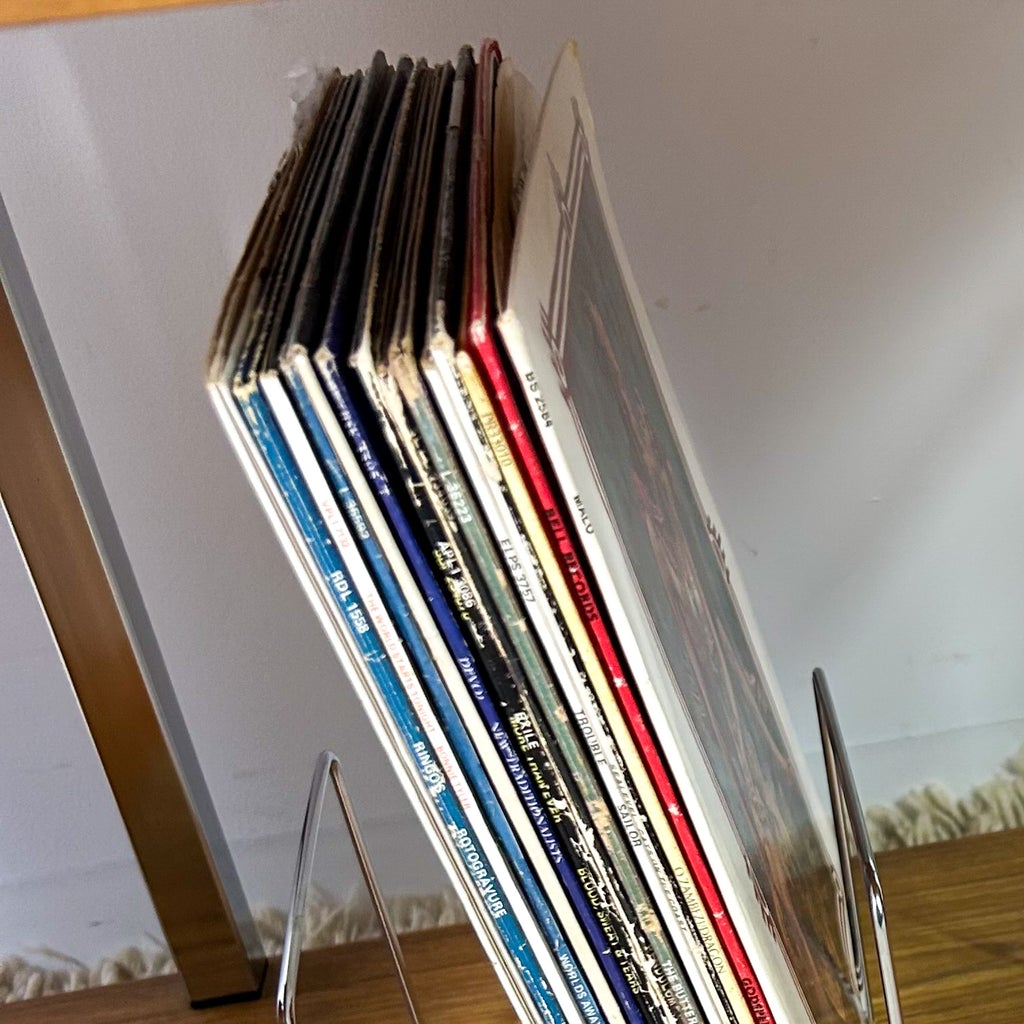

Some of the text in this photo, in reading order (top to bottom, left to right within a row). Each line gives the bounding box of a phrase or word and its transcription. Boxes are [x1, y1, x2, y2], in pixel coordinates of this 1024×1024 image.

[329, 569, 369, 634] RDL 1558
[516, 574, 535, 603] 3757
[365, 593, 435, 733] THE WORLD STARTS TONIGHT
[514, 711, 539, 749] EXILE
[574, 709, 606, 766] TROUBLE
[435, 745, 471, 809] BONNIE TYLER
[616, 803, 642, 847] SAILOR
[454, 827, 507, 918] ROTOGRAVURE
[558, 953, 587, 999] WORLDS
[661, 959, 678, 982] THE
